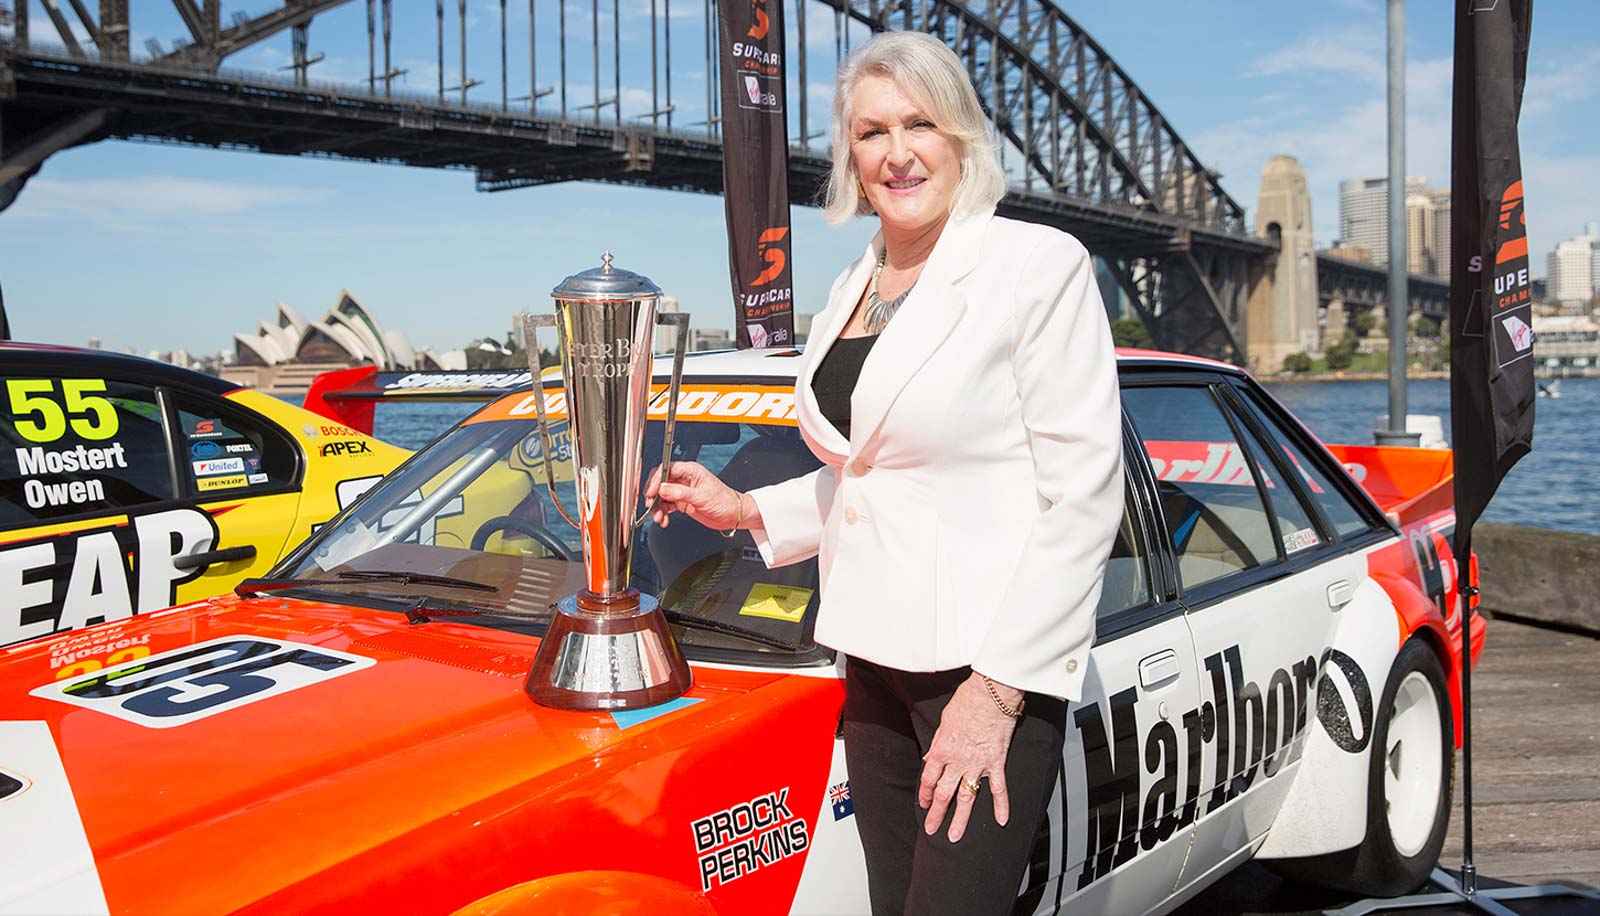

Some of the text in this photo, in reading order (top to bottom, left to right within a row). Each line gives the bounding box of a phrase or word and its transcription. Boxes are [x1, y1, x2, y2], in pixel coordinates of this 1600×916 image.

[6, 379, 120, 443] 55
[15, 442, 128, 475] Mostert
[208, 461, 239, 472] United
[25, 476, 105, 509] Owen
[207, 478, 245, 488] DUNLOP
[1073, 644, 1373, 891] Marlboro
[691, 787, 793, 853] BROCK
[699, 818, 808, 892] PERKINS
